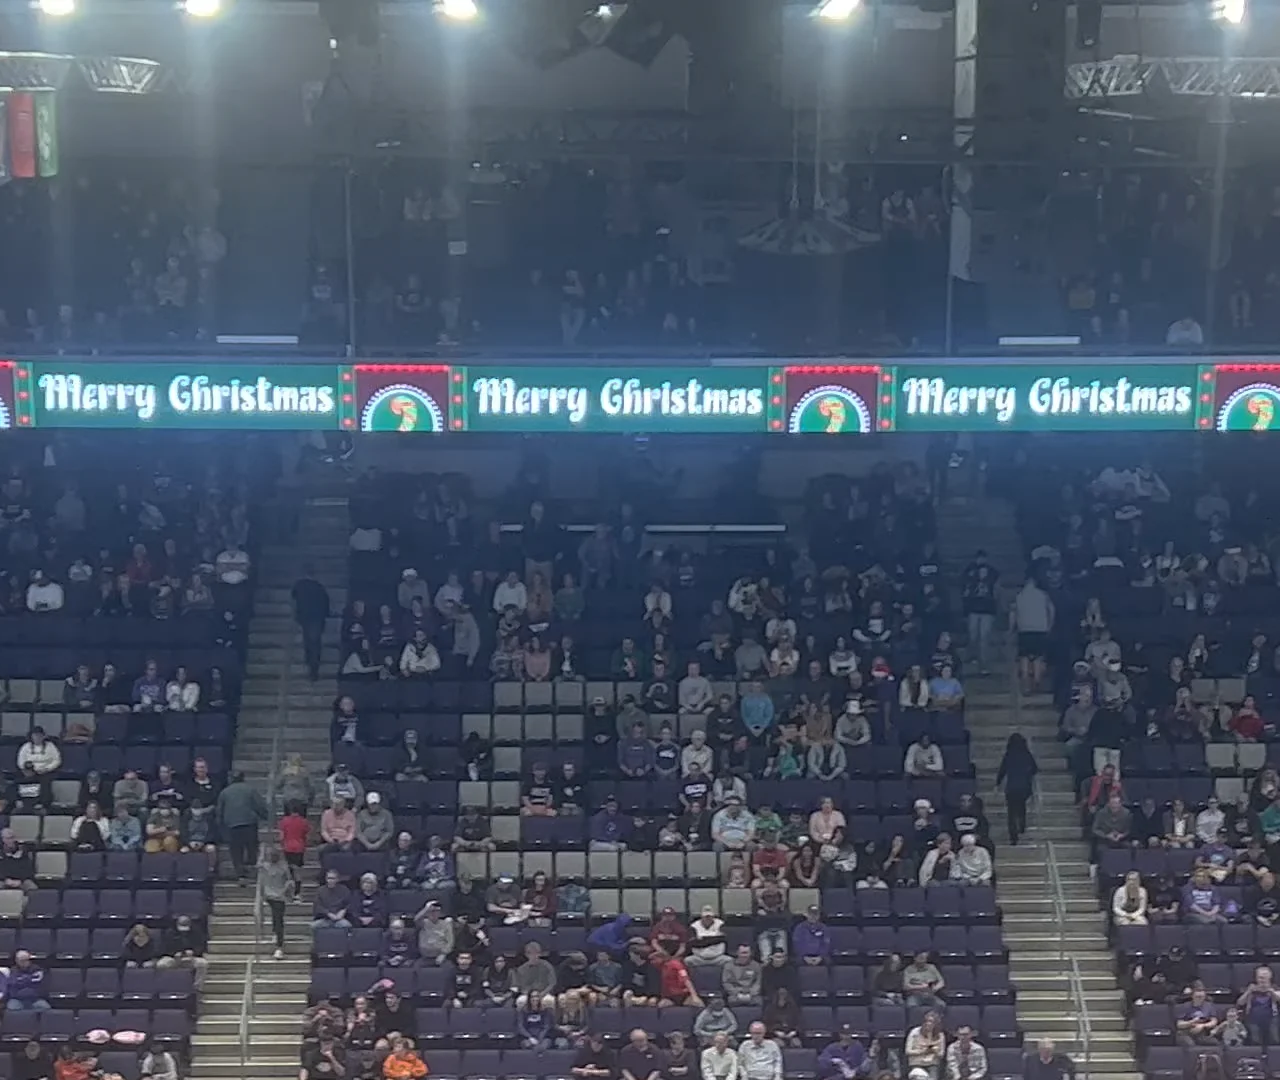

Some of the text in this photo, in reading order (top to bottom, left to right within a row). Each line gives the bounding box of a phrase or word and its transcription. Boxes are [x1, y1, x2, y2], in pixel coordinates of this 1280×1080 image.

[38, 374, 335, 419] Merry Christmas
[472, 378, 763, 423] Merry Christmas
[901, 377, 1191, 422] Merry Christmas
